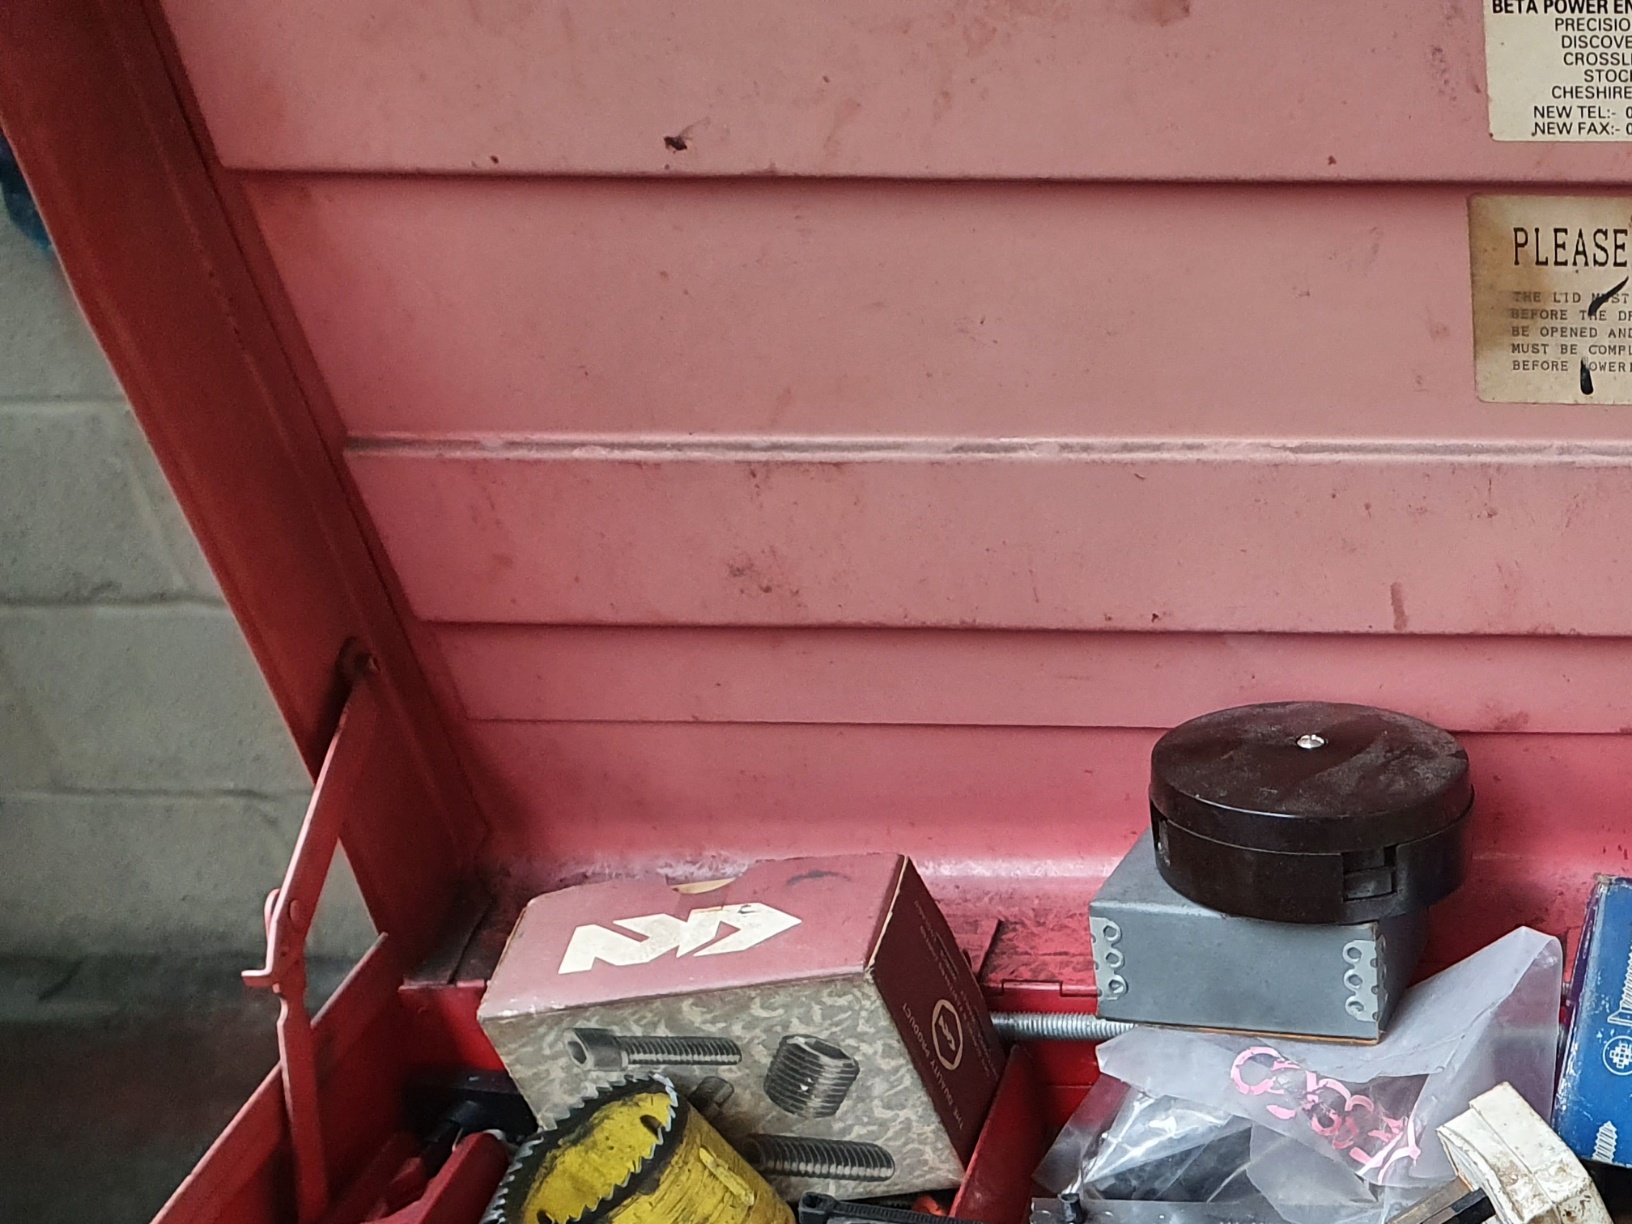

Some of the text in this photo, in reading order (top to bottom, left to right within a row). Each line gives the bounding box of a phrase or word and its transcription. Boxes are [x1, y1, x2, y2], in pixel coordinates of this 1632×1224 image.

[1492, 0, 1539, 14] BETA
[1543, 0, 1609, 14] POWER
[1551, 86, 1632, 100] CHESHIRE
[1534, 105, 1573, 119] NEW
[1576, 105, 1616, 119] TEL:-
[1534, 122, 1573, 136] NEW
[1577, 122, 1621, 136] FAX:-
[1513, 227, 1628, 268] PLEASE
[1513, 291, 1541, 303] THE
[1553, 291, 1581, 303] LID
[1511, 308, 1568, 320] BEFORE
[1511, 326, 1530, 337] BE
[1540, 326, 1598, 338] OPENED
[1511, 343, 1549, 354] MUST
[1560, 344, 1578, 355] BE
[1512, 360, 1569, 371] BEFORE
